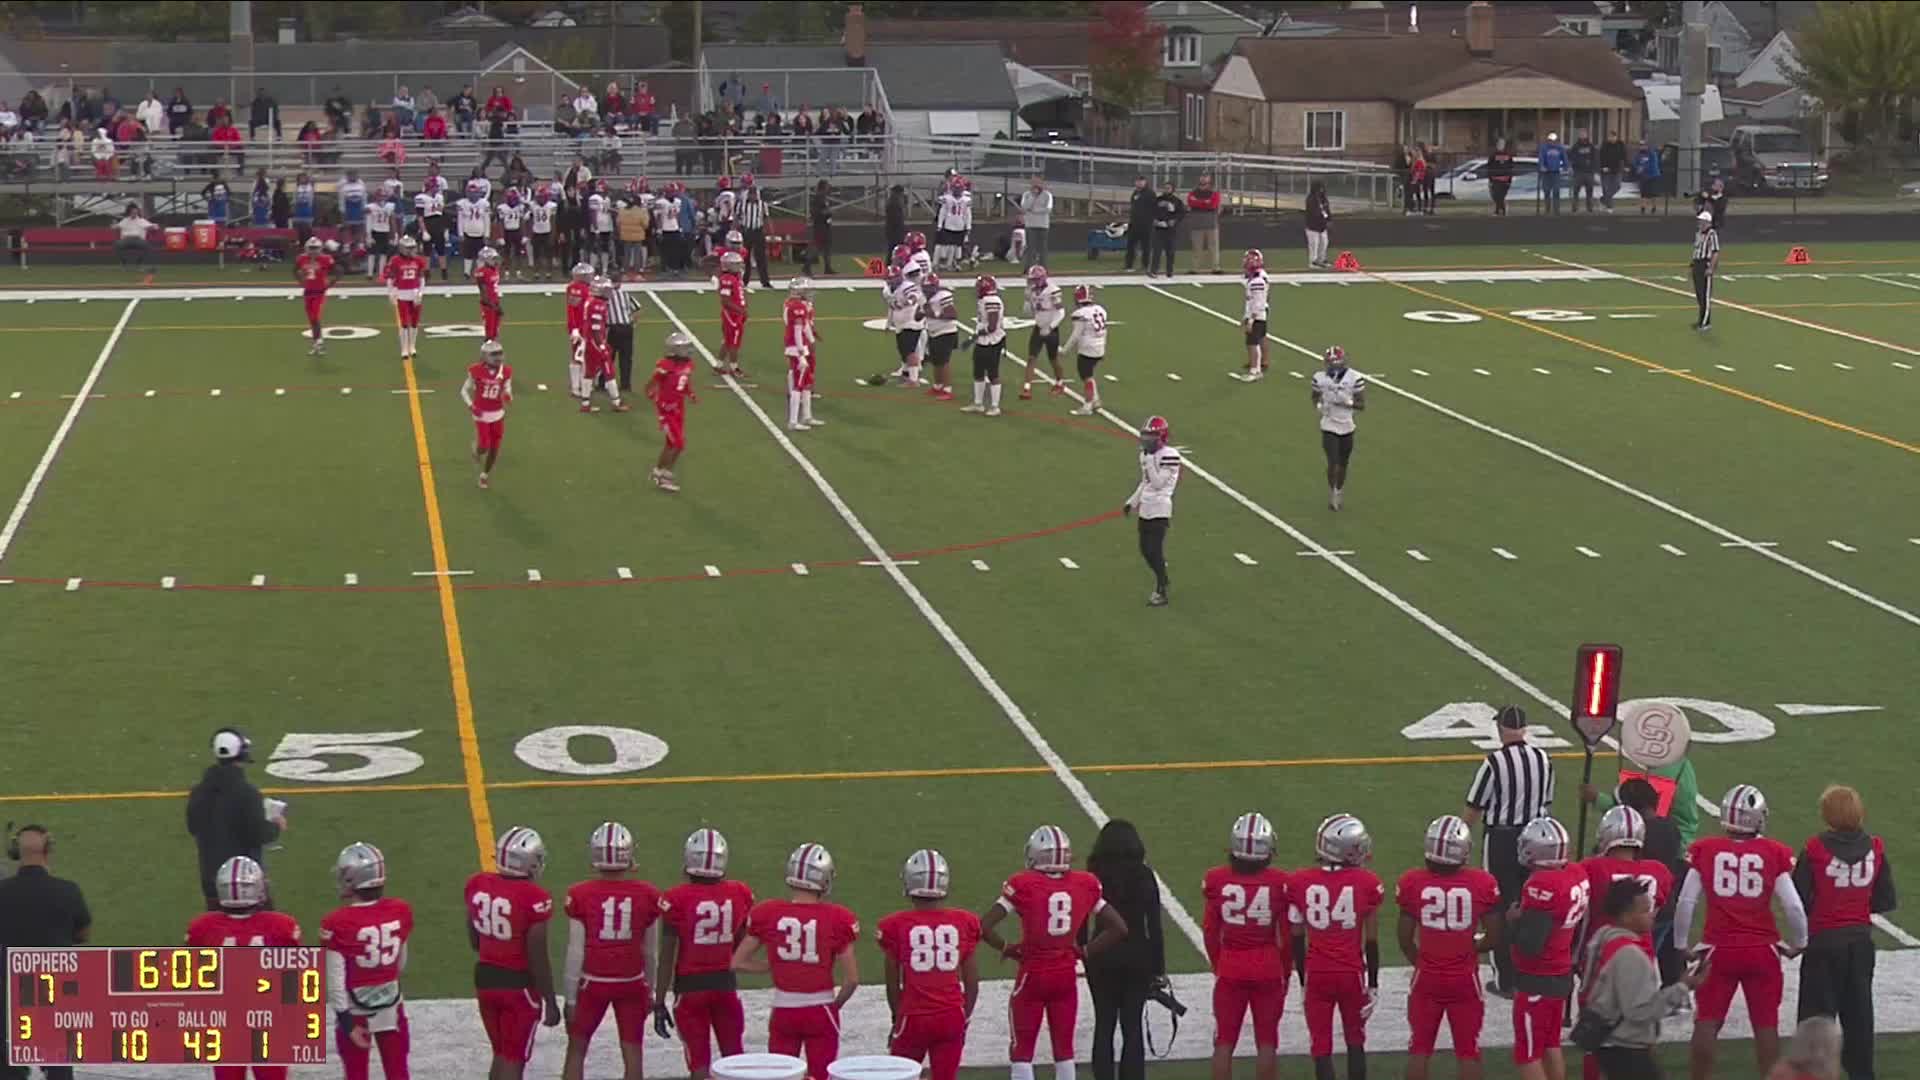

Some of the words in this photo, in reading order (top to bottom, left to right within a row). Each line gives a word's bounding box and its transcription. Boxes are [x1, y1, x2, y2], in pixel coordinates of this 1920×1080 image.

[1712, 851, 1764, 897] 66
[1825, 849, 1875, 888] 40
[472, 891, 512, 940] 36
[601, 896, 632, 940] 11
[693, 900, 734, 945] 21
[1047, 891, 1072, 936] 8
[1221, 884, 1272, 926] 24
[1305, 884, 1357, 930] 84
[1421, 886, 1473, 930] 20
[356, 920, 401, 968] 35
[776, 916, 819, 963] 31
[908, 924, 960, 972] 88
